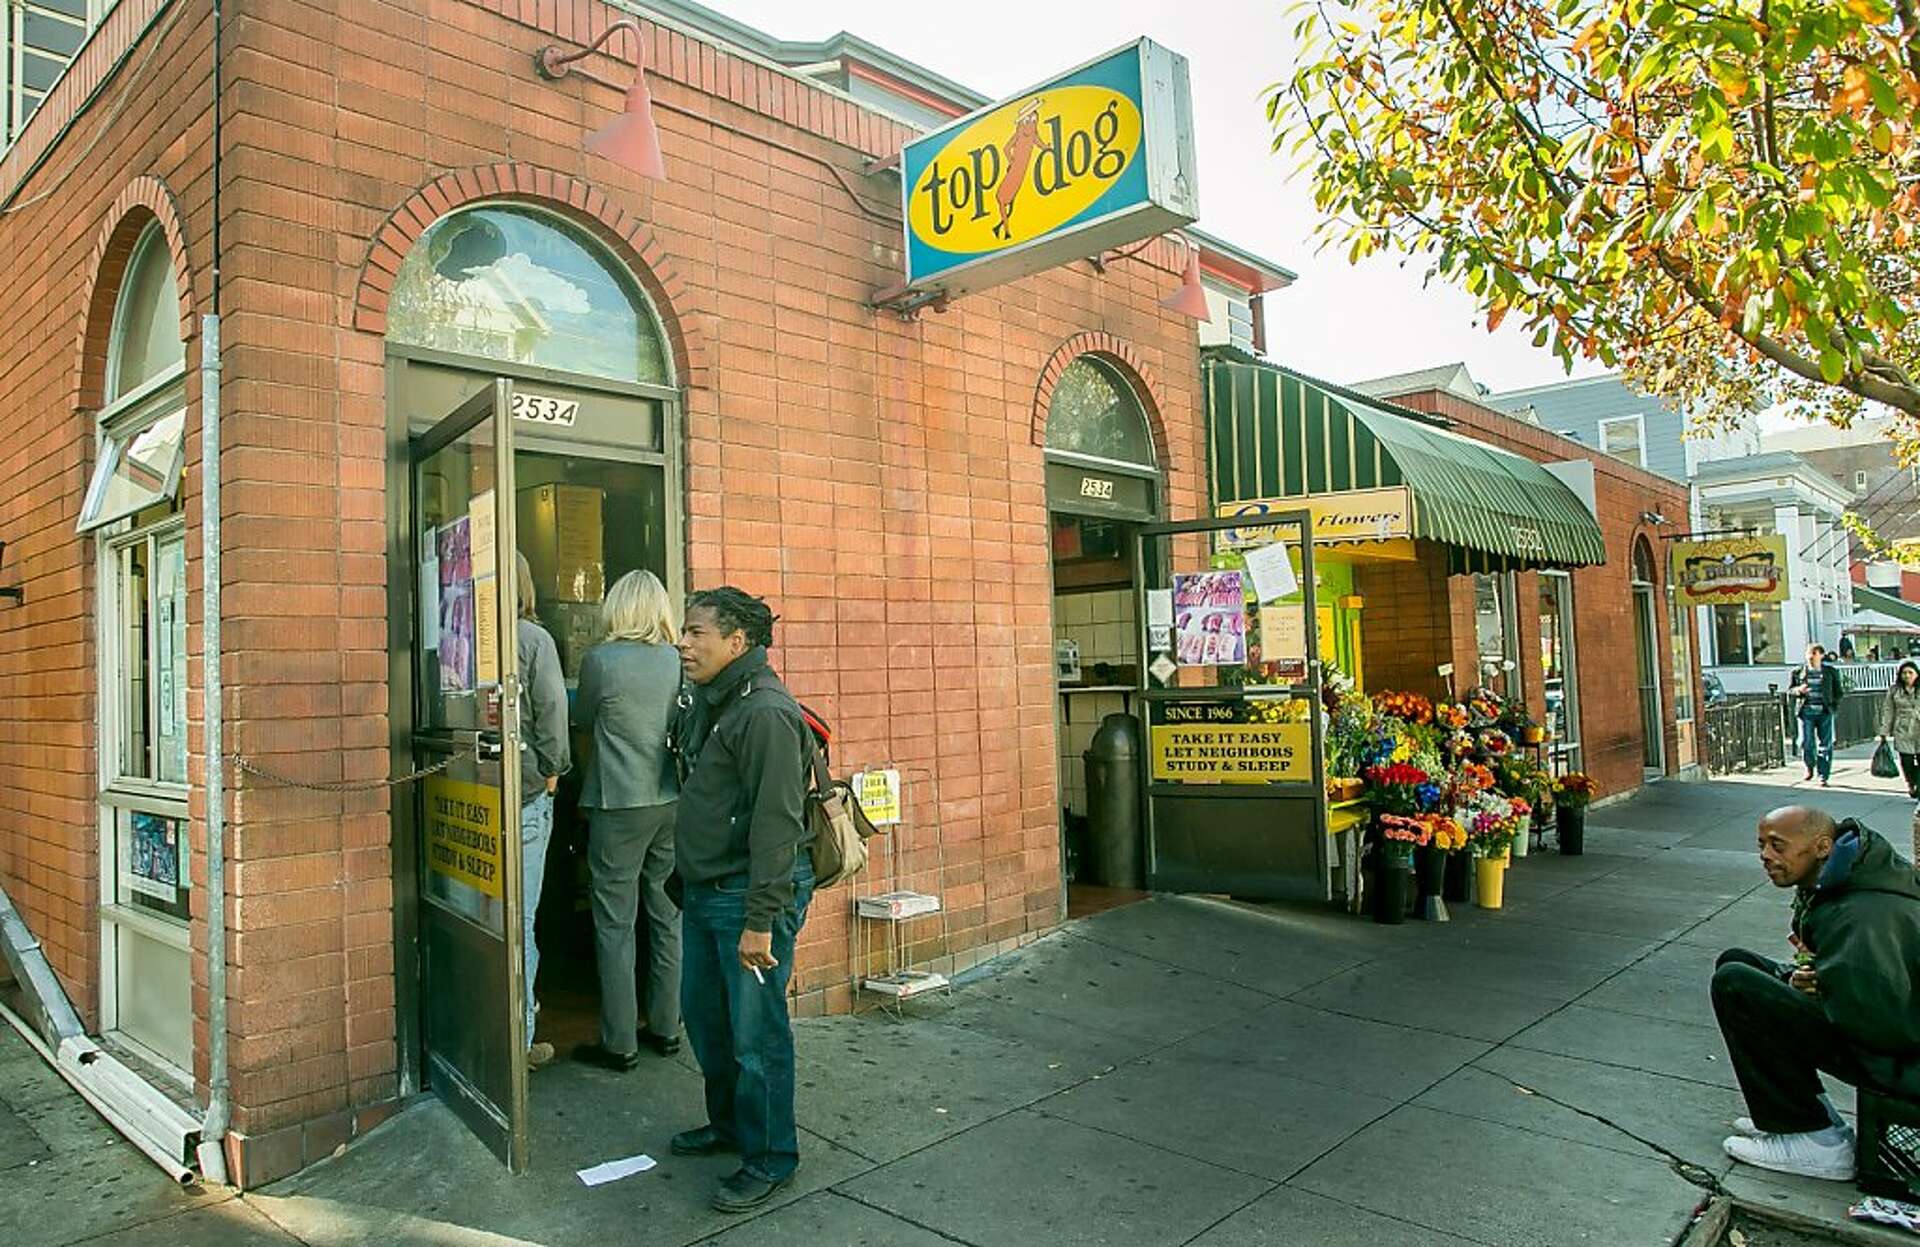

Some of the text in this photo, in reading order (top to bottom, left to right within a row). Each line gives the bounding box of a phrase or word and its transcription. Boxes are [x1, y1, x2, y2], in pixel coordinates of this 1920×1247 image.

[921, 99, 1127, 235] top dog
[512, 395, 576, 424] 2534
[1083, 479, 1111, 496] 2534
[1318, 511, 1402, 527] Flowers
[1165, 706, 1234, 720] SINCE 1966
[1171, 732, 1282, 745] TAKE IT EASY
[1164, 746, 1294, 758] LET NEIGHBORS
[1166, 760, 1291, 772] STUDY & SLEEP
[466, 803, 491, 826] EASY
[466, 855, 496, 882] SLEEP
